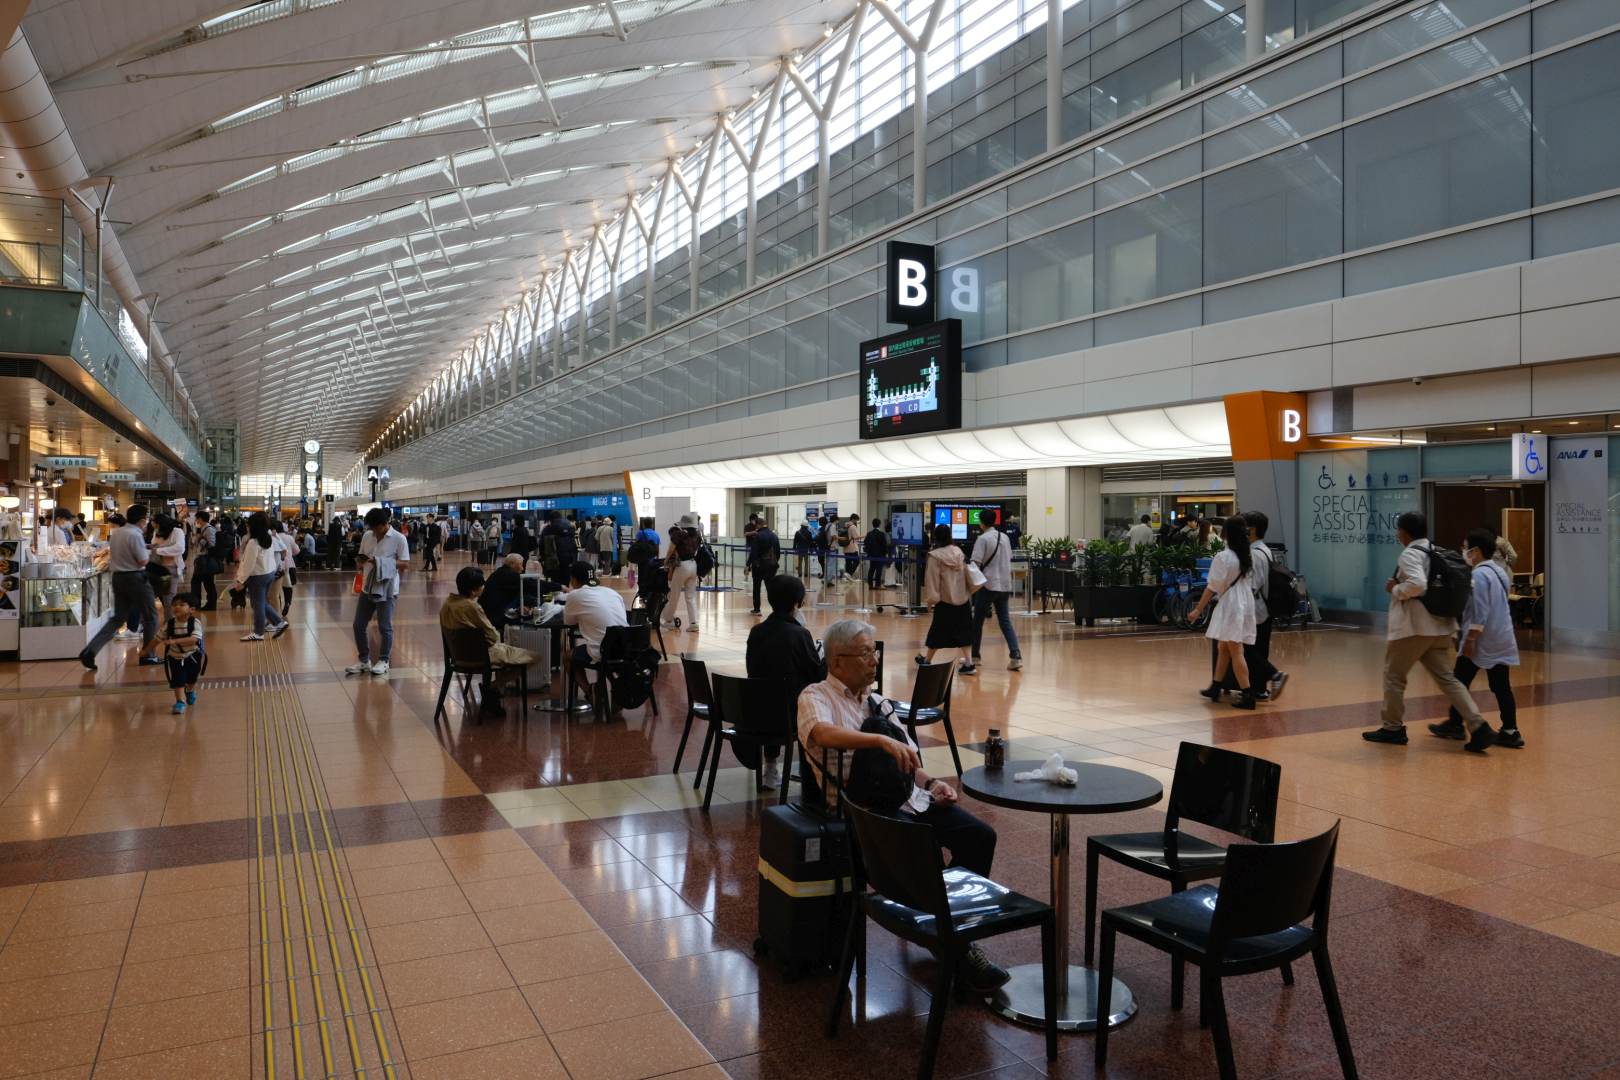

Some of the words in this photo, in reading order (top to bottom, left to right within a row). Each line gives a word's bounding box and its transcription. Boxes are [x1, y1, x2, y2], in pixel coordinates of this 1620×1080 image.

[898, 258, 928, 307] B
[1283, 409, 1301, 442] B
[1557, 450, 1579, 460] ANA
[368, 468, 378, 479] A
[643, 487, 651, 500] B
[1313, 495, 1378, 513] SPECIAL
[1313, 513, 1400, 530] ASSISTANC
[1313, 533, 1401, 544] お手伝いが必要なお
